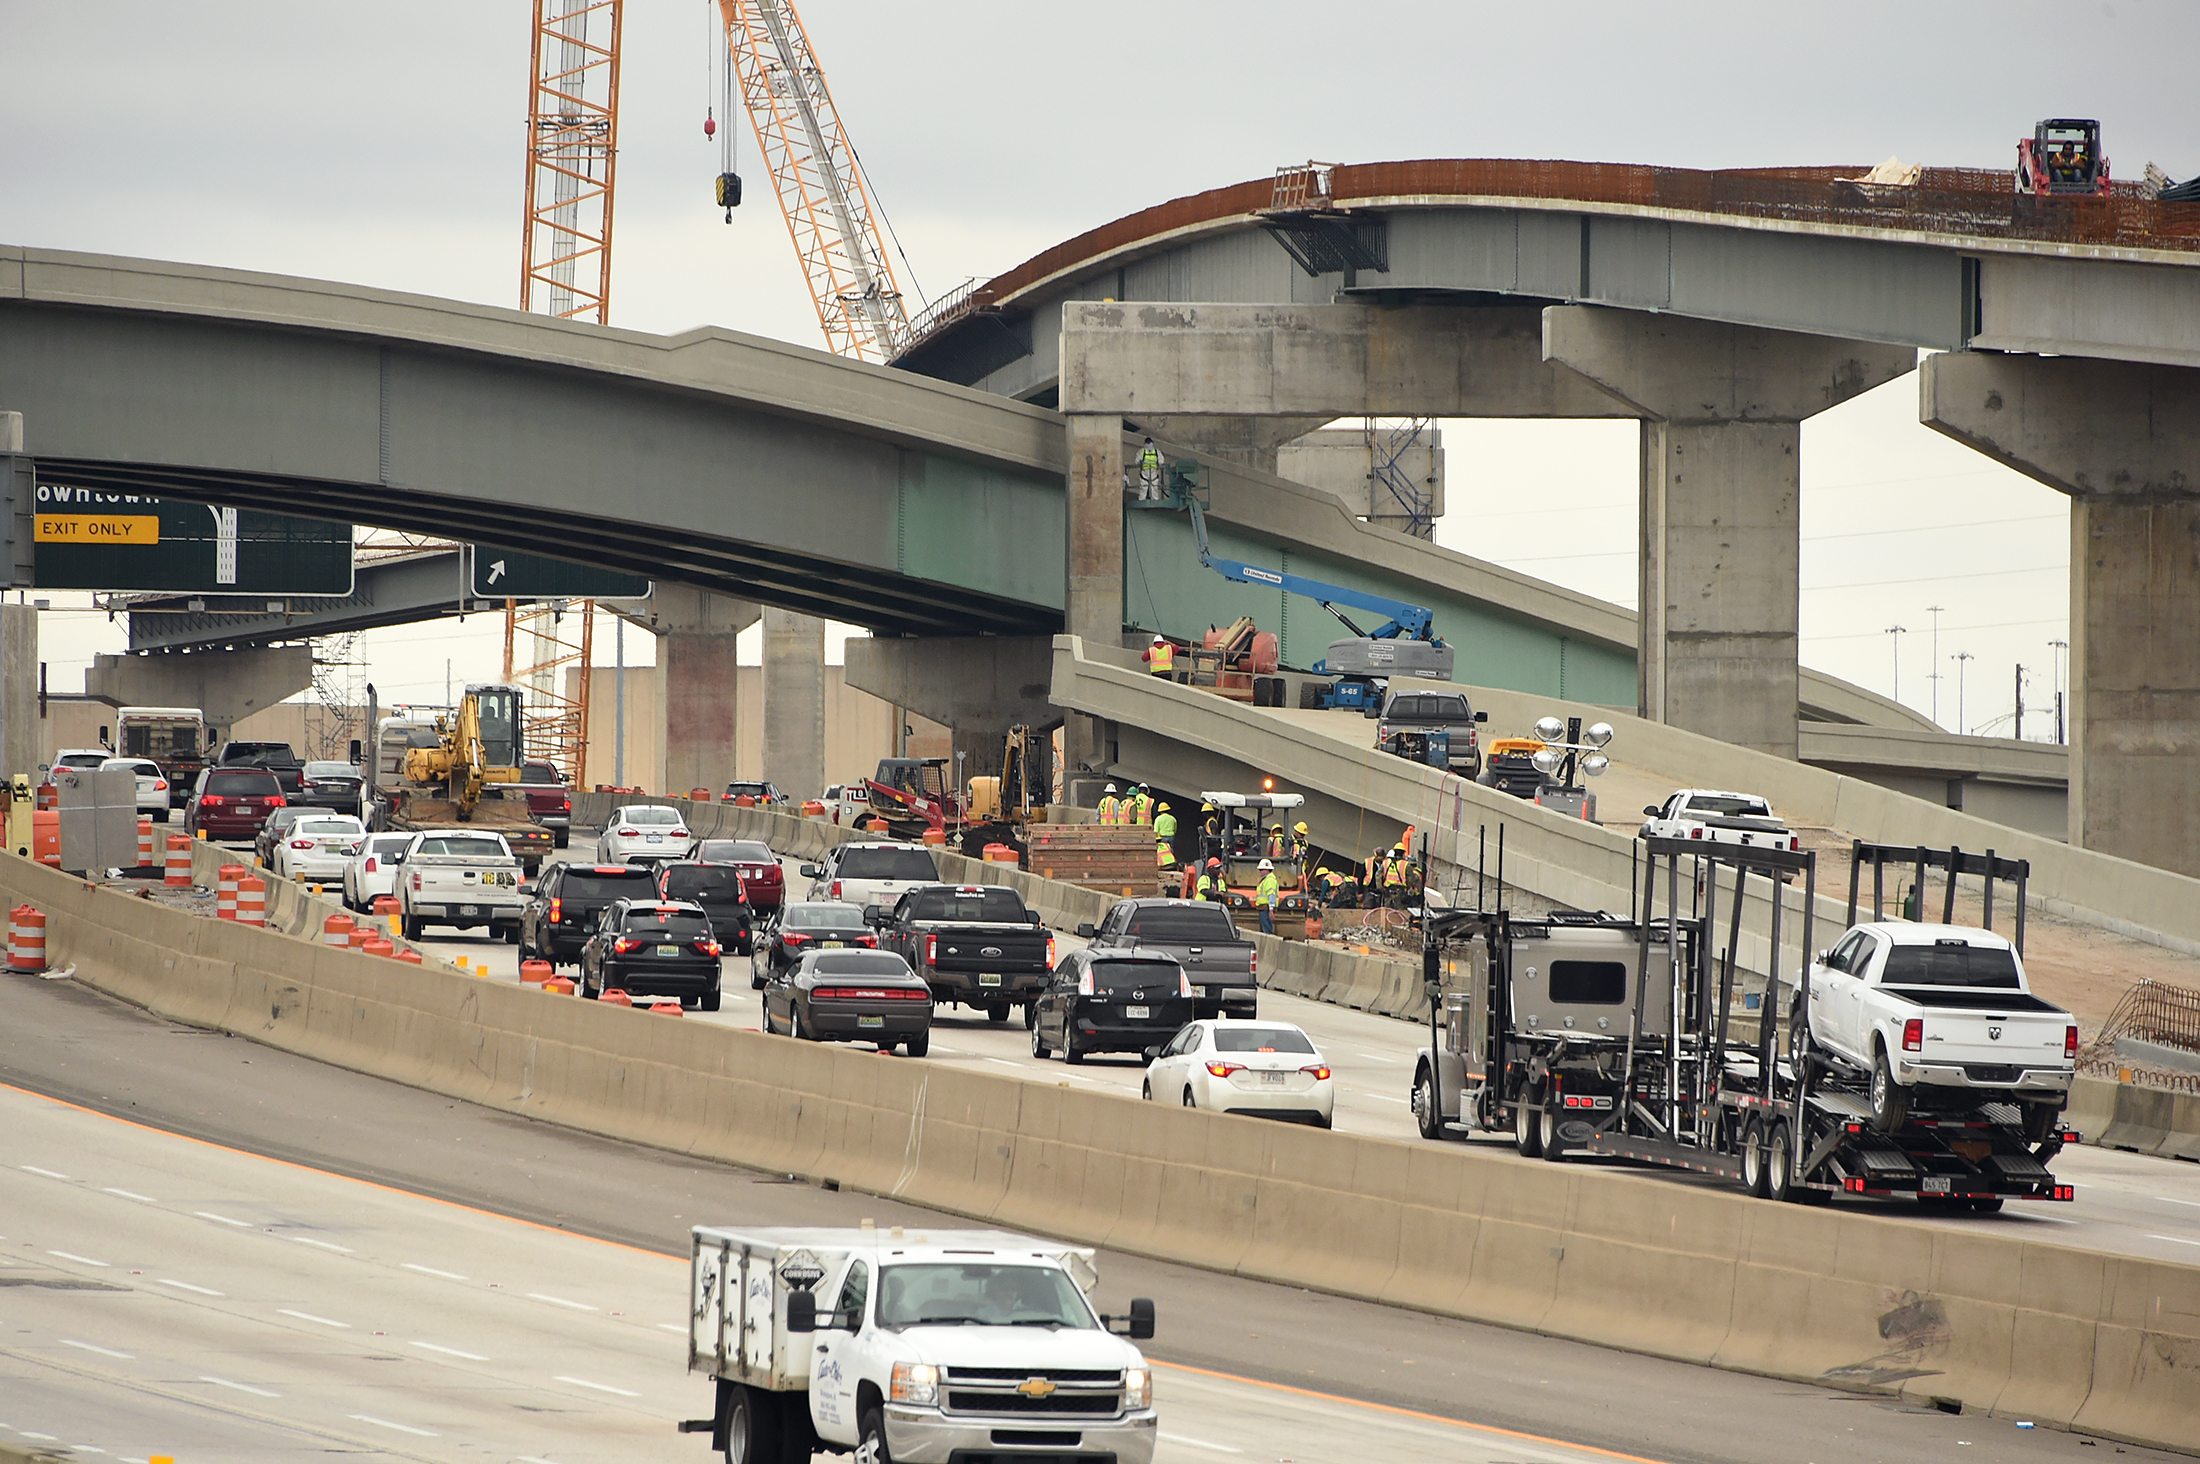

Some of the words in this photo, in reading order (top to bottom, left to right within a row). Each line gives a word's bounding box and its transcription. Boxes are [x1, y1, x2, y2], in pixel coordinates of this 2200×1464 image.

[43, 522, 79, 535] EXIT
[88, 523, 133, 536] ONLY
[1340, 687, 1358, 695] S-65
[783, 1268, 821, 1280] CORROSIVE
